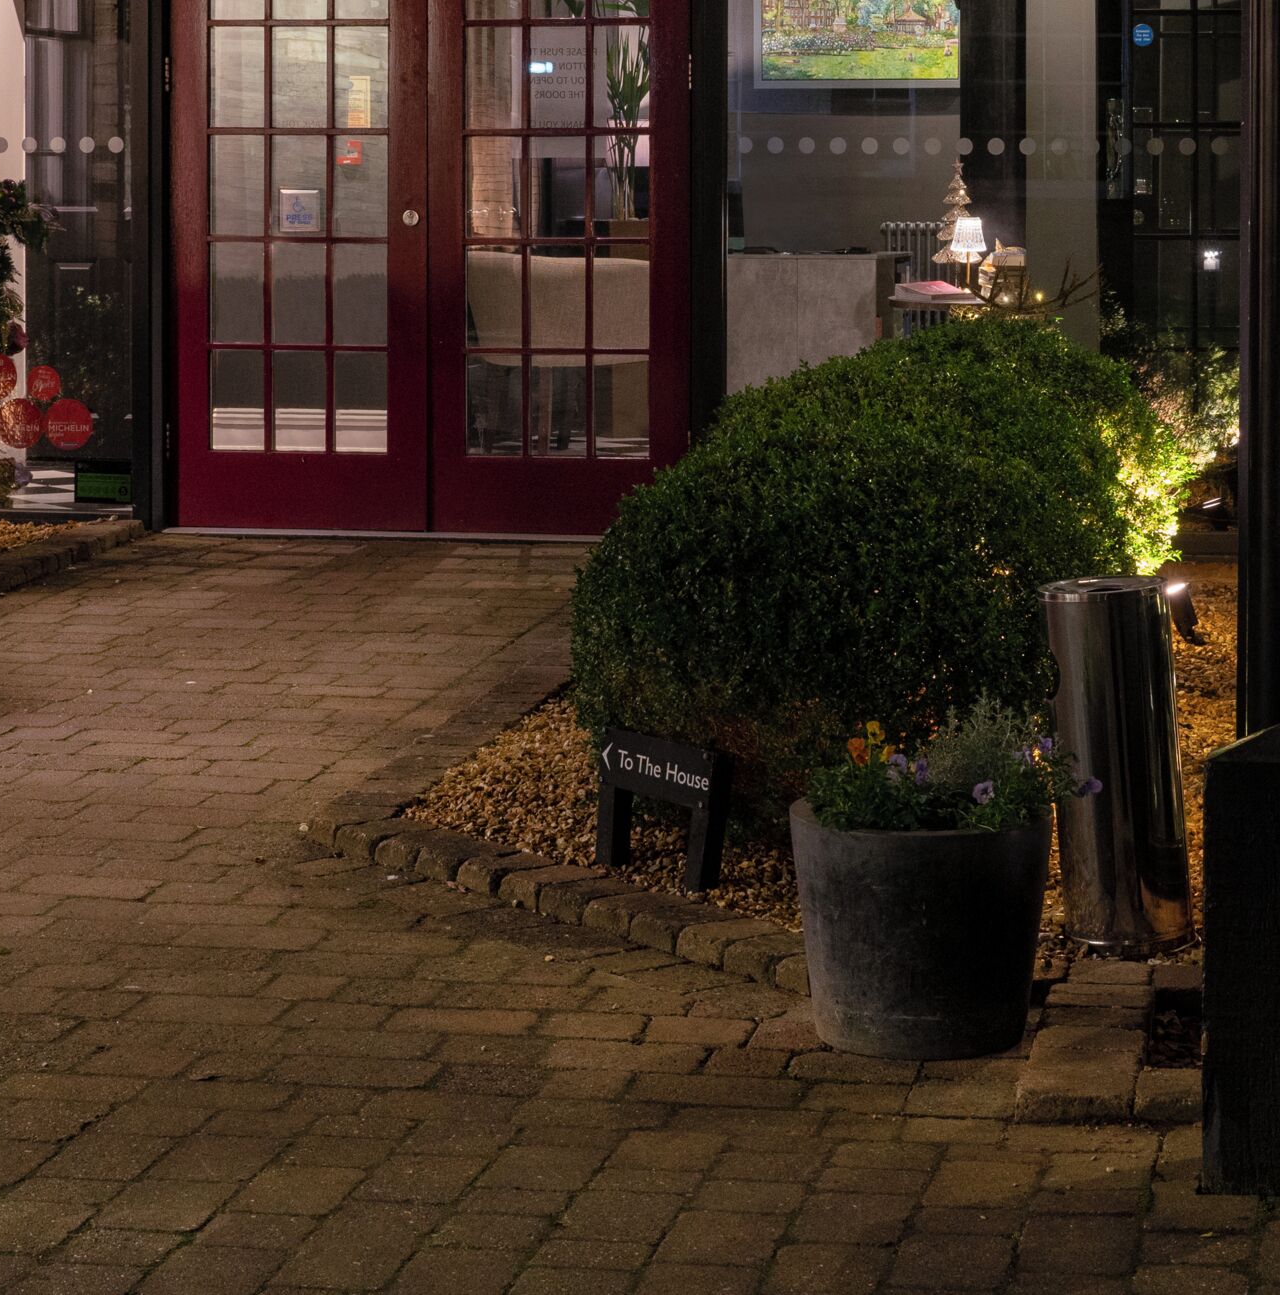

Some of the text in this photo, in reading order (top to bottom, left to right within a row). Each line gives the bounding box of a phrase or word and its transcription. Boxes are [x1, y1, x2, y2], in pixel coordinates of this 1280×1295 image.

[48, 424, 90, 432] MICHELIN
[617, 749, 709, 791] To The House
